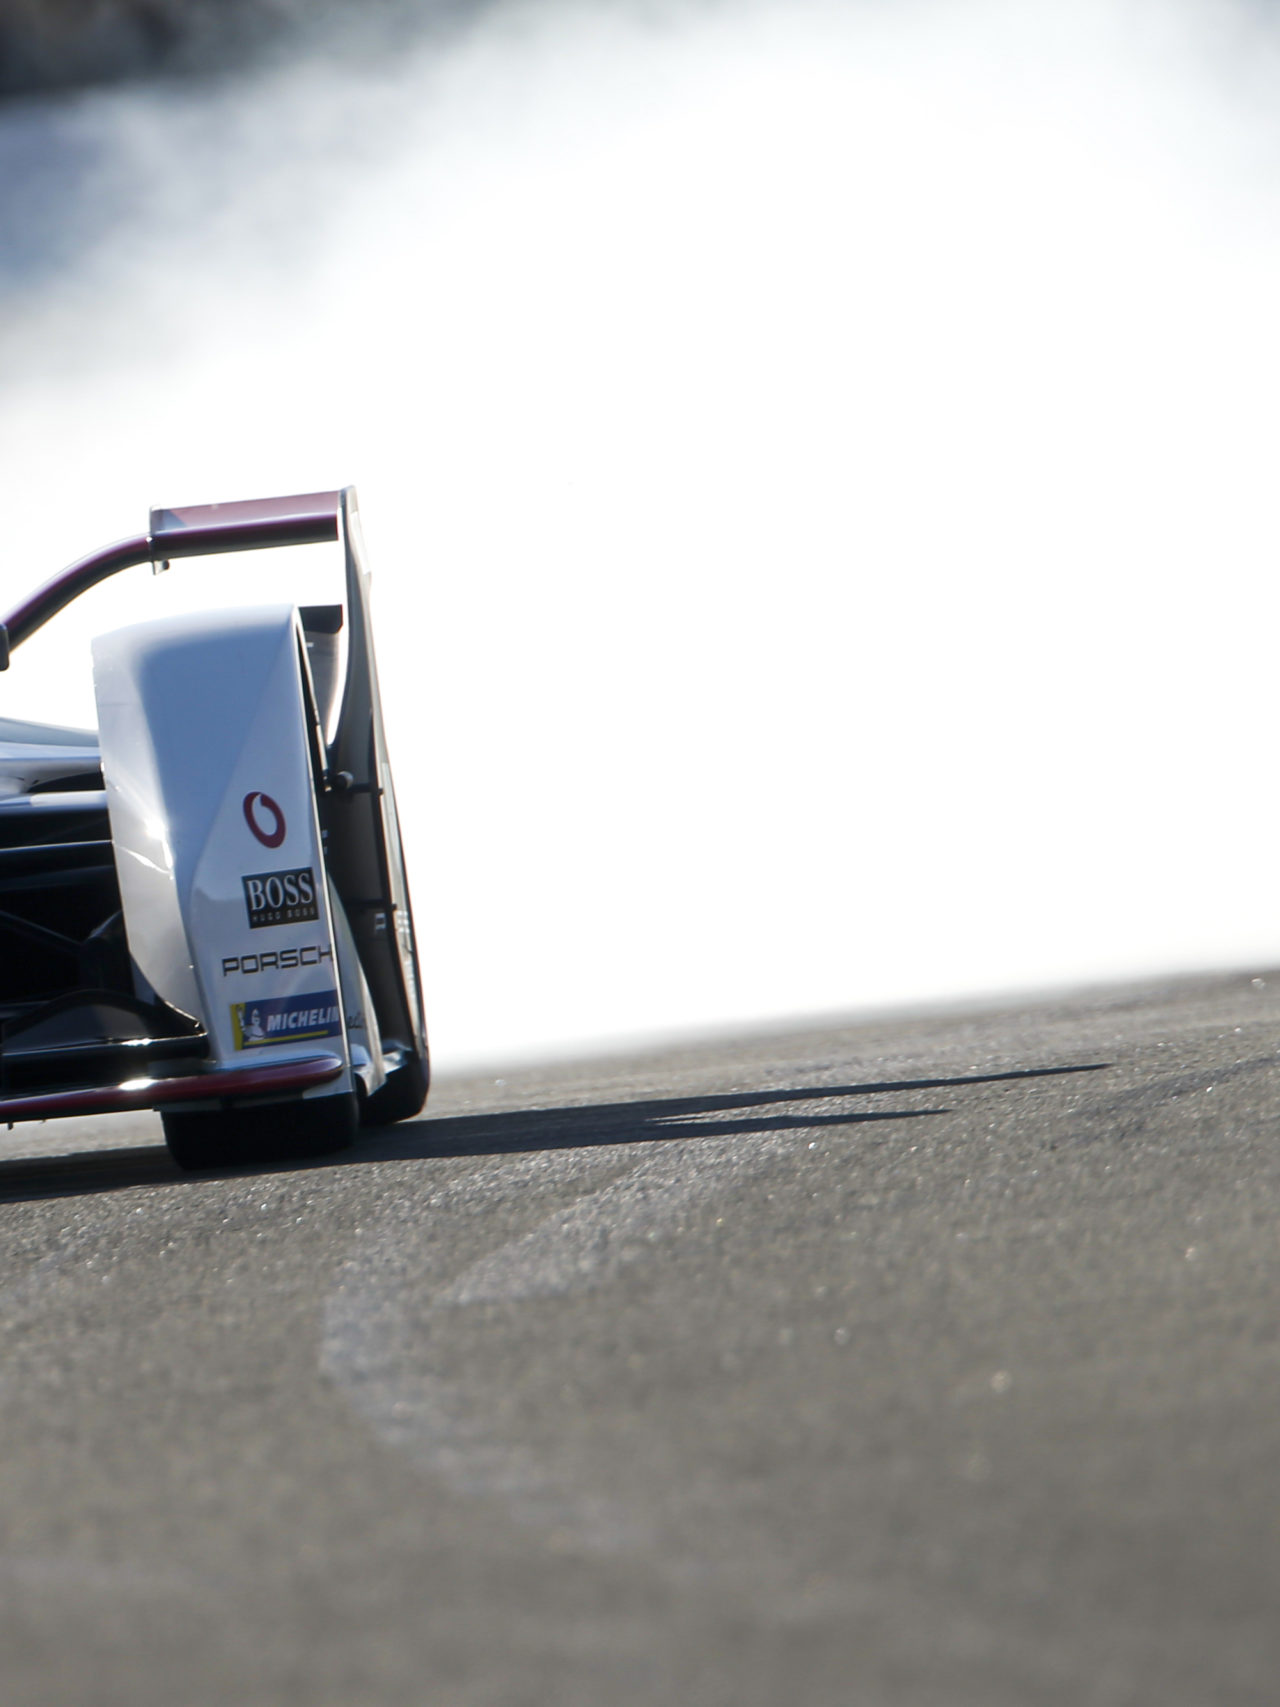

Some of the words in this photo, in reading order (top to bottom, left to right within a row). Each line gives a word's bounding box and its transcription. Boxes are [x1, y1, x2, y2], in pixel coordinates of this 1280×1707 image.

[246, 872, 314, 911] BOSS
[252, 912, 282, 923] HUGO
[287, 907, 317, 919] BOSS
[222, 944, 334, 977] PORSCH
[266, 1005, 340, 1032] MICHELIN
